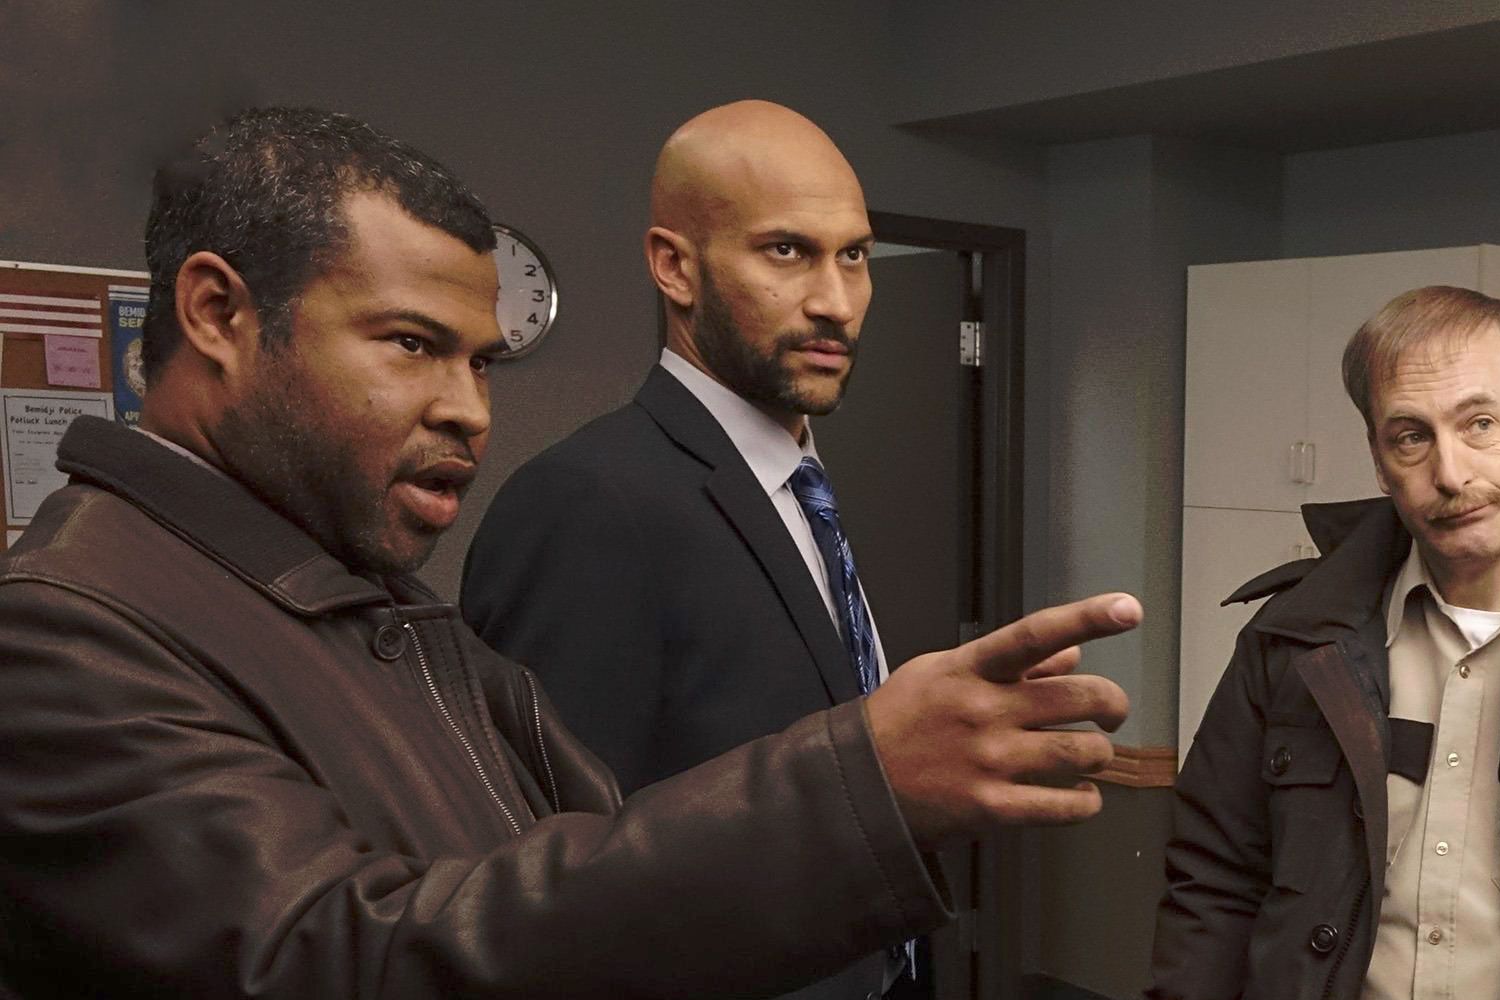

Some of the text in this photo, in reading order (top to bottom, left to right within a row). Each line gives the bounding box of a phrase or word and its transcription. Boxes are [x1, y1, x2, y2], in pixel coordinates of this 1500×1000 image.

[511, 244, 516, 257] 1
[525, 264, 537, 277] 2
[531, 289, 545, 303] 3
[526, 312, 538, 325] 4
[510, 330, 523, 342] 5
[25, 405, 82, 416] Bemidji Police
[10, 416, 68, 426] Potluck Lunch
